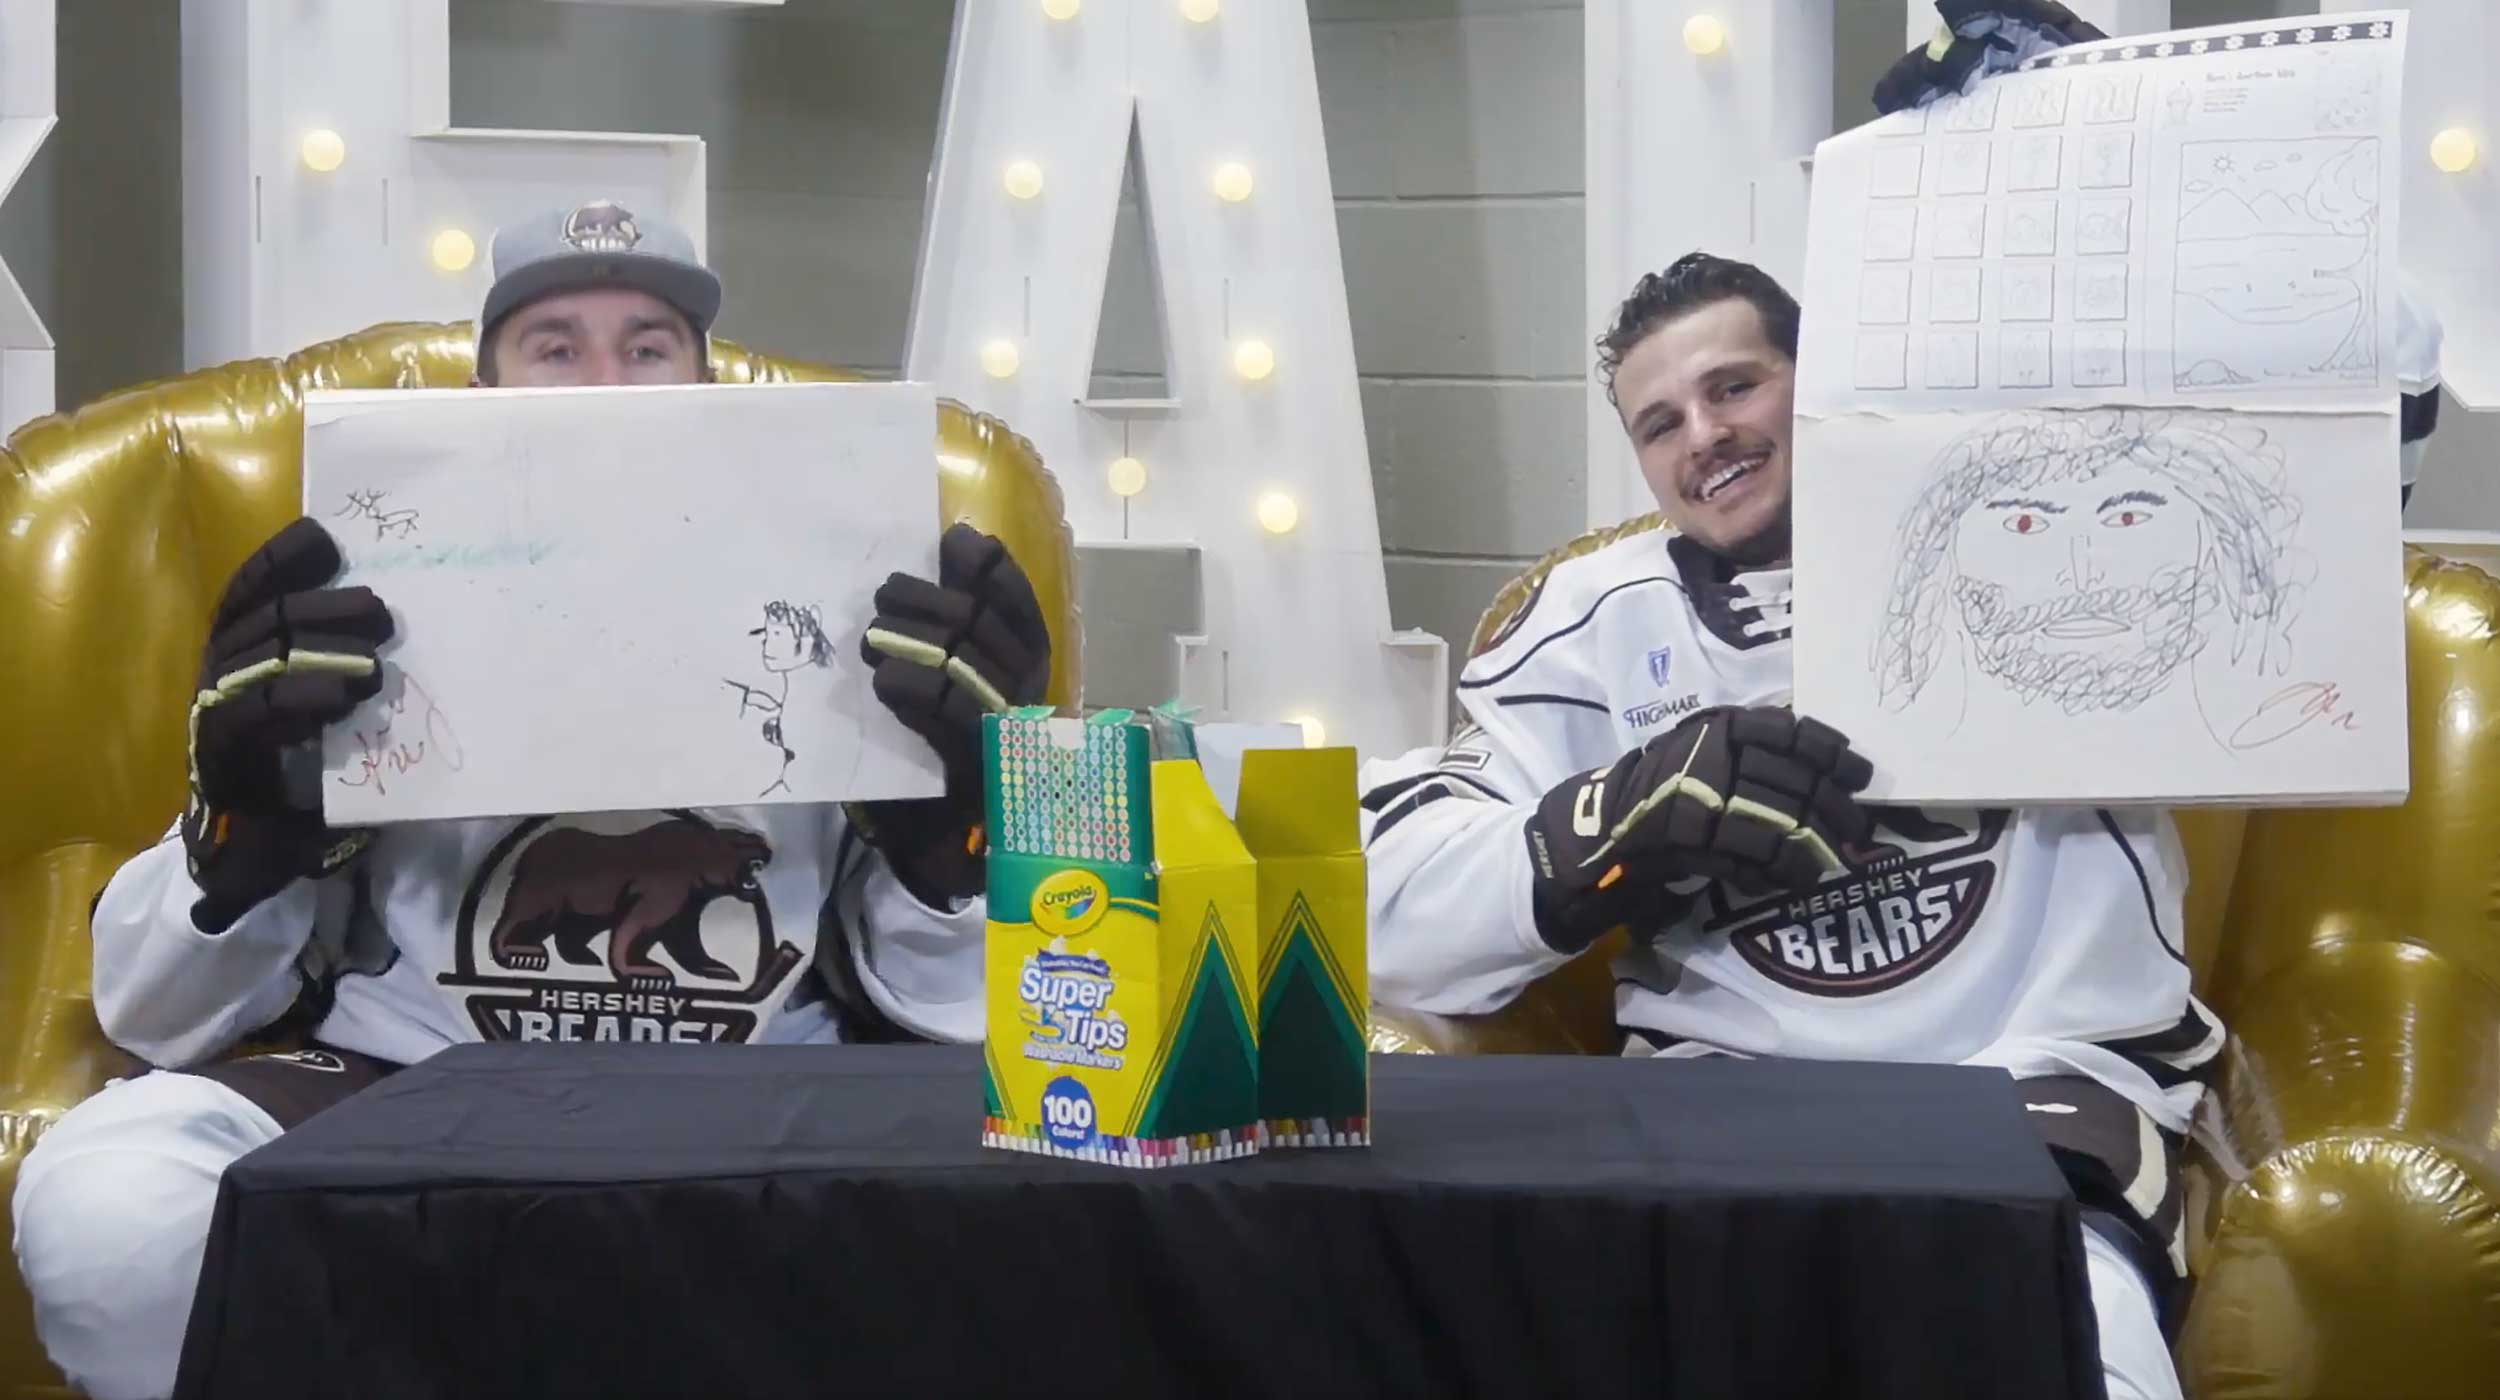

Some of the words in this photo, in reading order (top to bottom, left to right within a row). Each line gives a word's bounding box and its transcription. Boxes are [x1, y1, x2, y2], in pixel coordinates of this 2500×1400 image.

[1043, 885, 1092, 905] Crayola
[1788, 868, 1922, 920] HERSHEY
[1777, 884, 1952, 975] BEARS
[540, 989, 684, 1016] HERSHEY
[1020, 966, 1114, 1011] Super
[1065, 1010, 1128, 1052] Tips
[1043, 1094, 1092, 1128] 100
